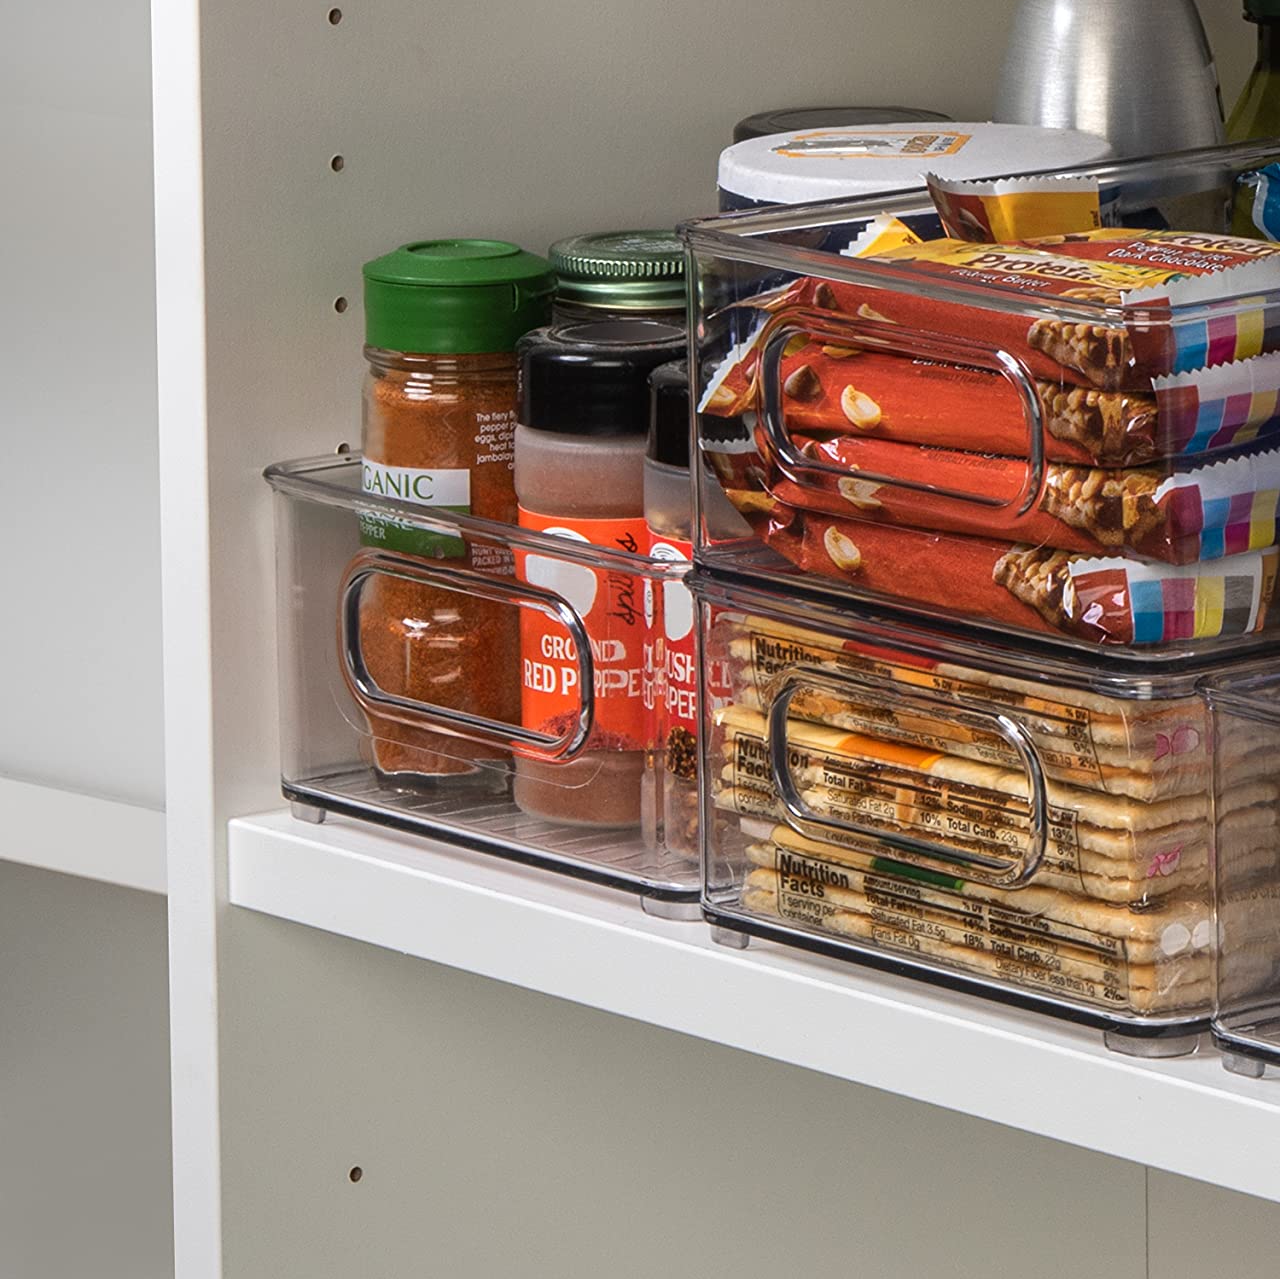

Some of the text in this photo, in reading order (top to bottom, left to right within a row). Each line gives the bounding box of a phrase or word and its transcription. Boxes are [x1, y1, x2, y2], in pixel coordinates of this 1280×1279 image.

[963, 252, 1100, 281] Protein
[1108, 249, 1142, 259] Dark
[524, 659, 556, 693] RED
[780, 855, 849, 888] Nutrition
[781, 876, 824, 897] Facts
[990, 940, 1043, 963] Total Carb.
